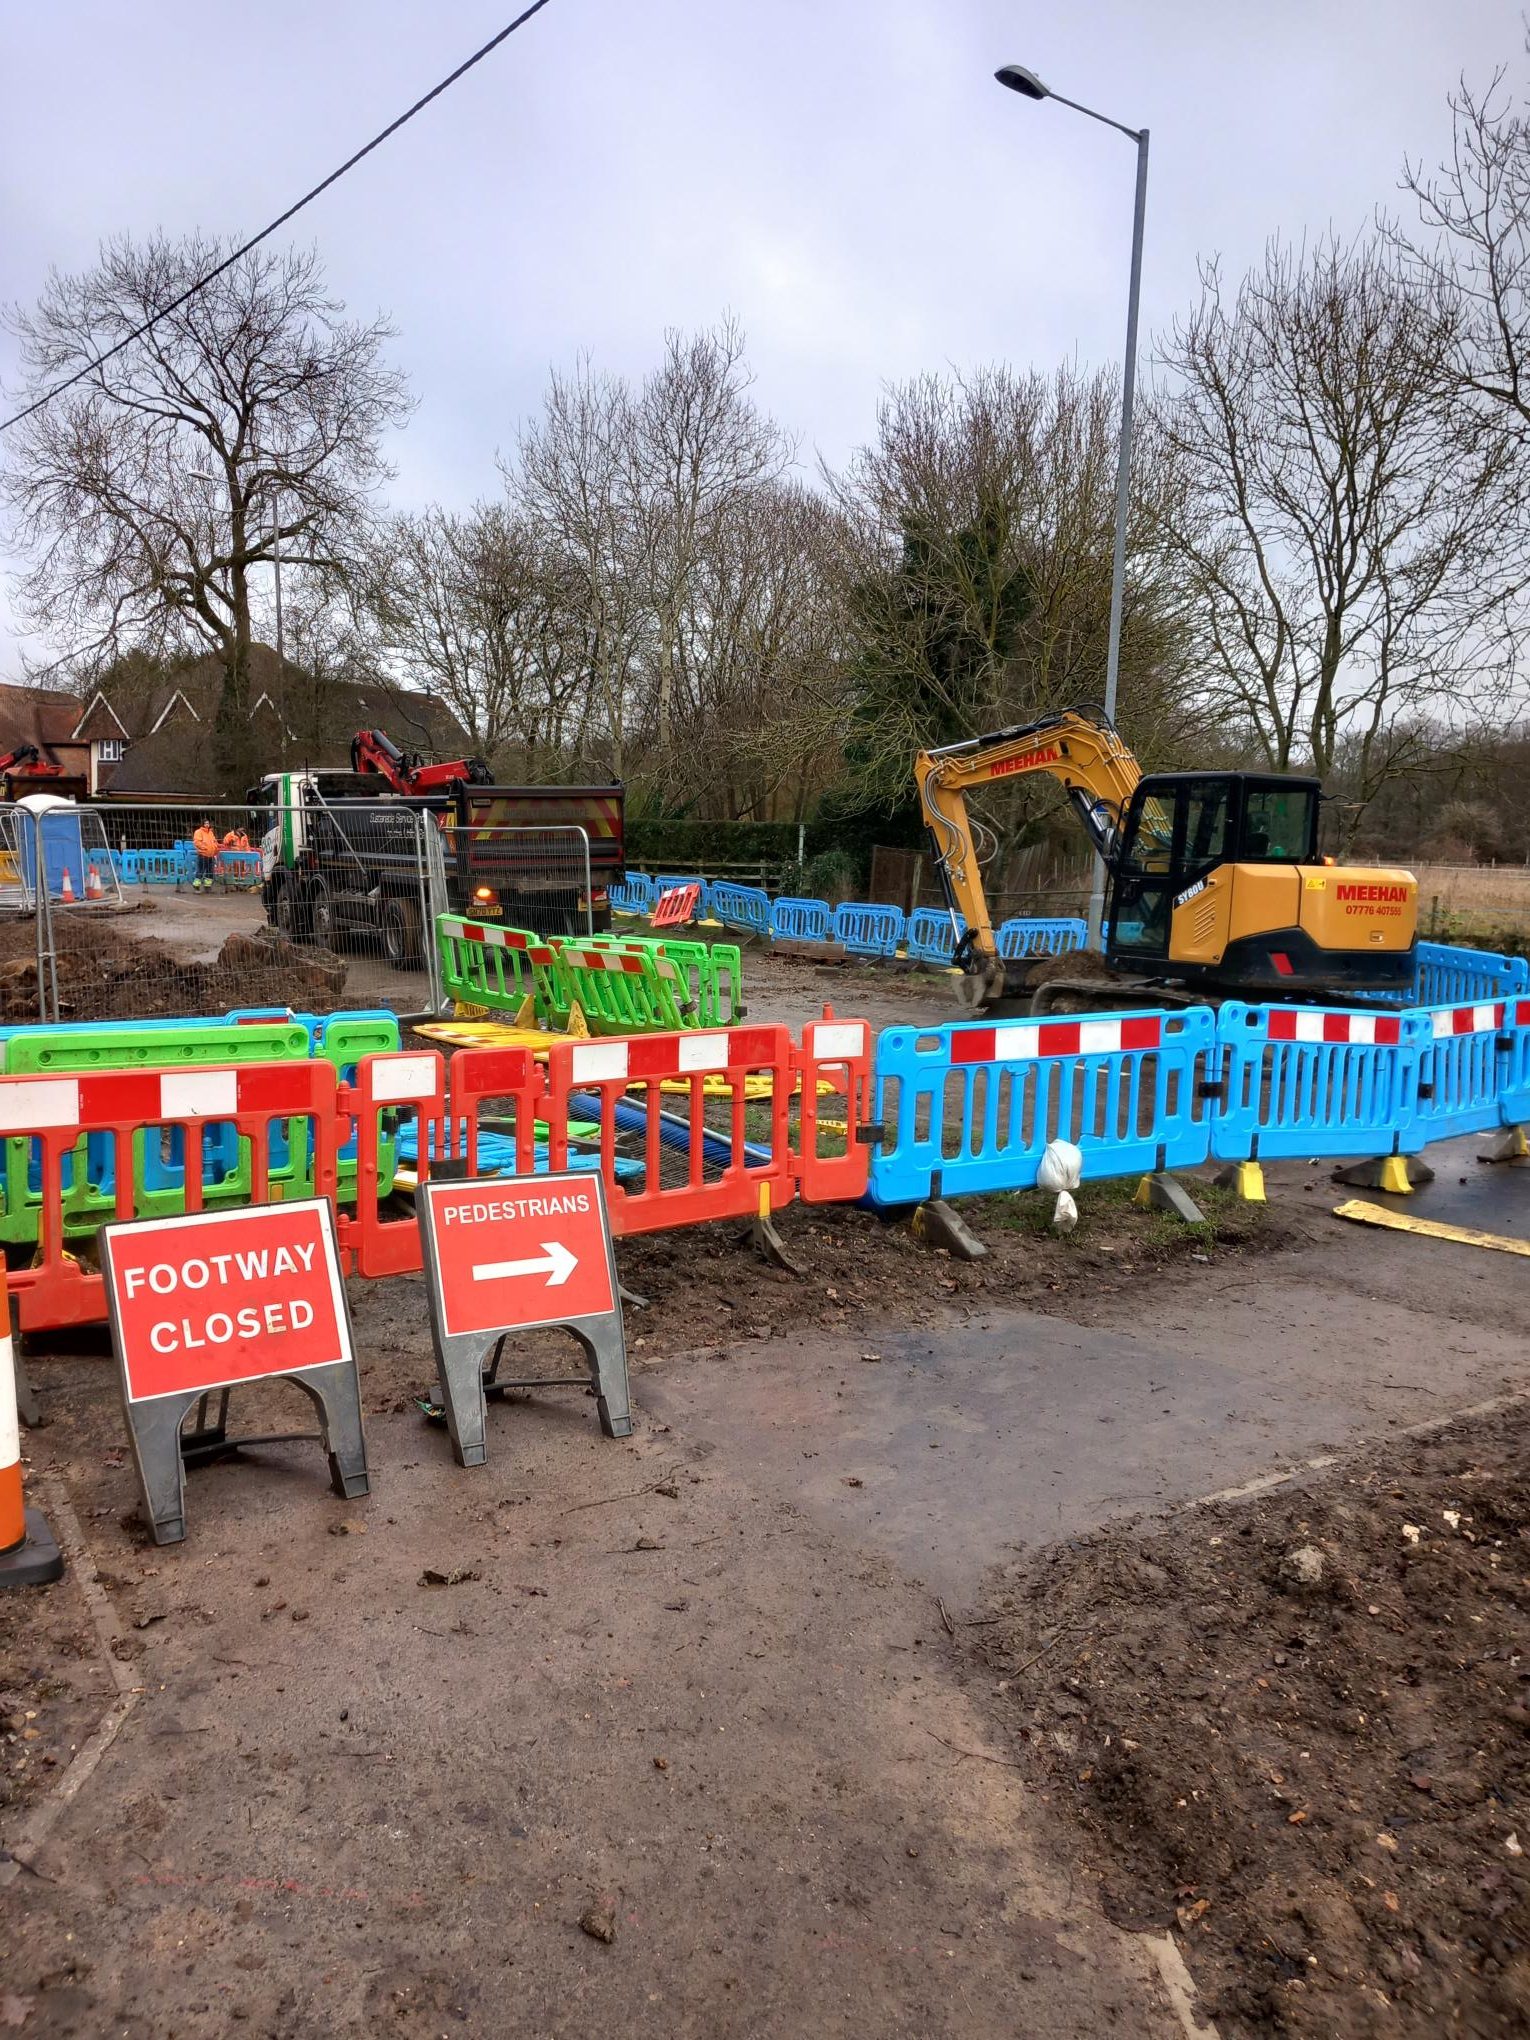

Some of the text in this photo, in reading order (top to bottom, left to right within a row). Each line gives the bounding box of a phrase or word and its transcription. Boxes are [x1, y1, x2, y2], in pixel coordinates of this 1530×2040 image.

[990, 746, 1058, 777] MEEHAN
[1336, 884, 1407, 902] MEEHAN
[1345, 905, 1402, 916] 07776 407555
[444, 1194, 590, 1226] PEDESTRIANS
[124, 1242, 315, 1299] FOOTWAY
[150, 1299, 314, 1353] CLOSED
